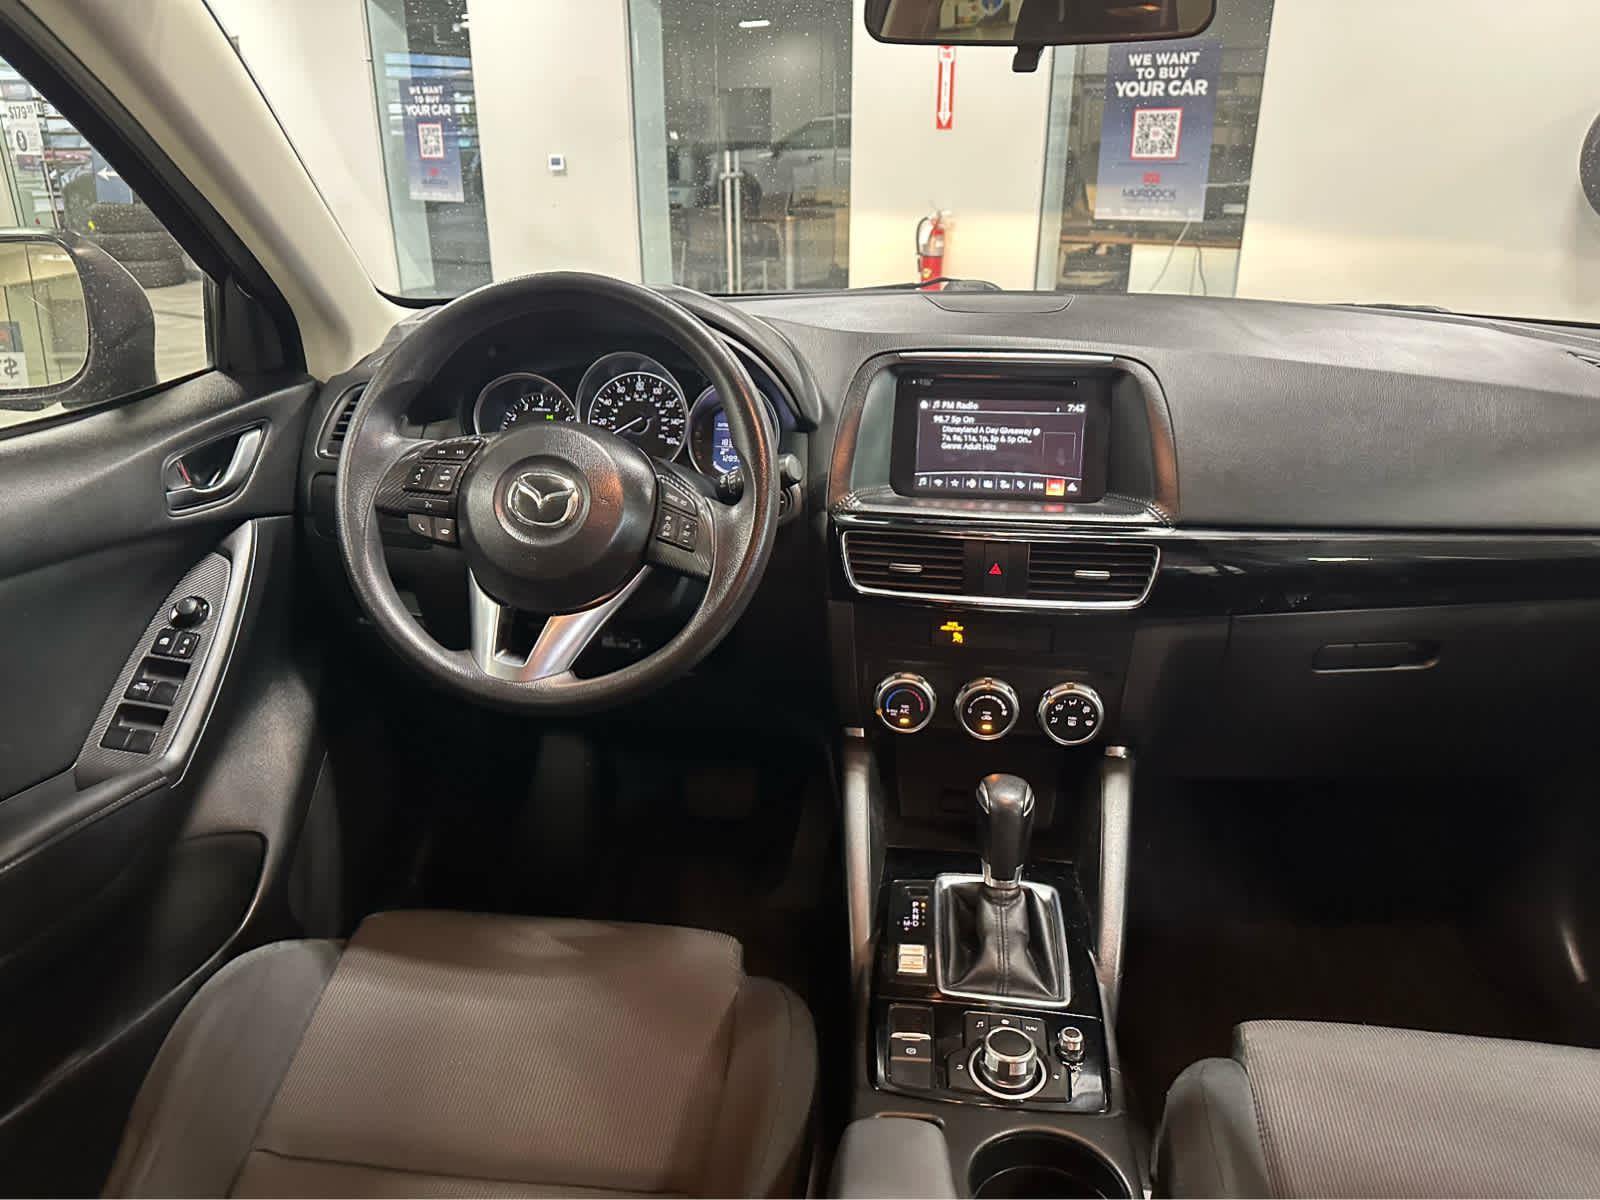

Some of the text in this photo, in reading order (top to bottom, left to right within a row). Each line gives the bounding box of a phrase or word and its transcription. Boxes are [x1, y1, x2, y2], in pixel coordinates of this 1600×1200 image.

[1128, 51, 1201, 67] WE WANT
[1136, 65, 1189, 80] TO BUY
[1114, 78, 1209, 98] YOUR CAR
[404, 103, 451, 117] YOUR CAR
[941, 400, 979, 410] FM Radio
[962, 415, 975, 424] On
[985, 426, 1000, 435] Day
[962, 442, 982, 451] Adult
